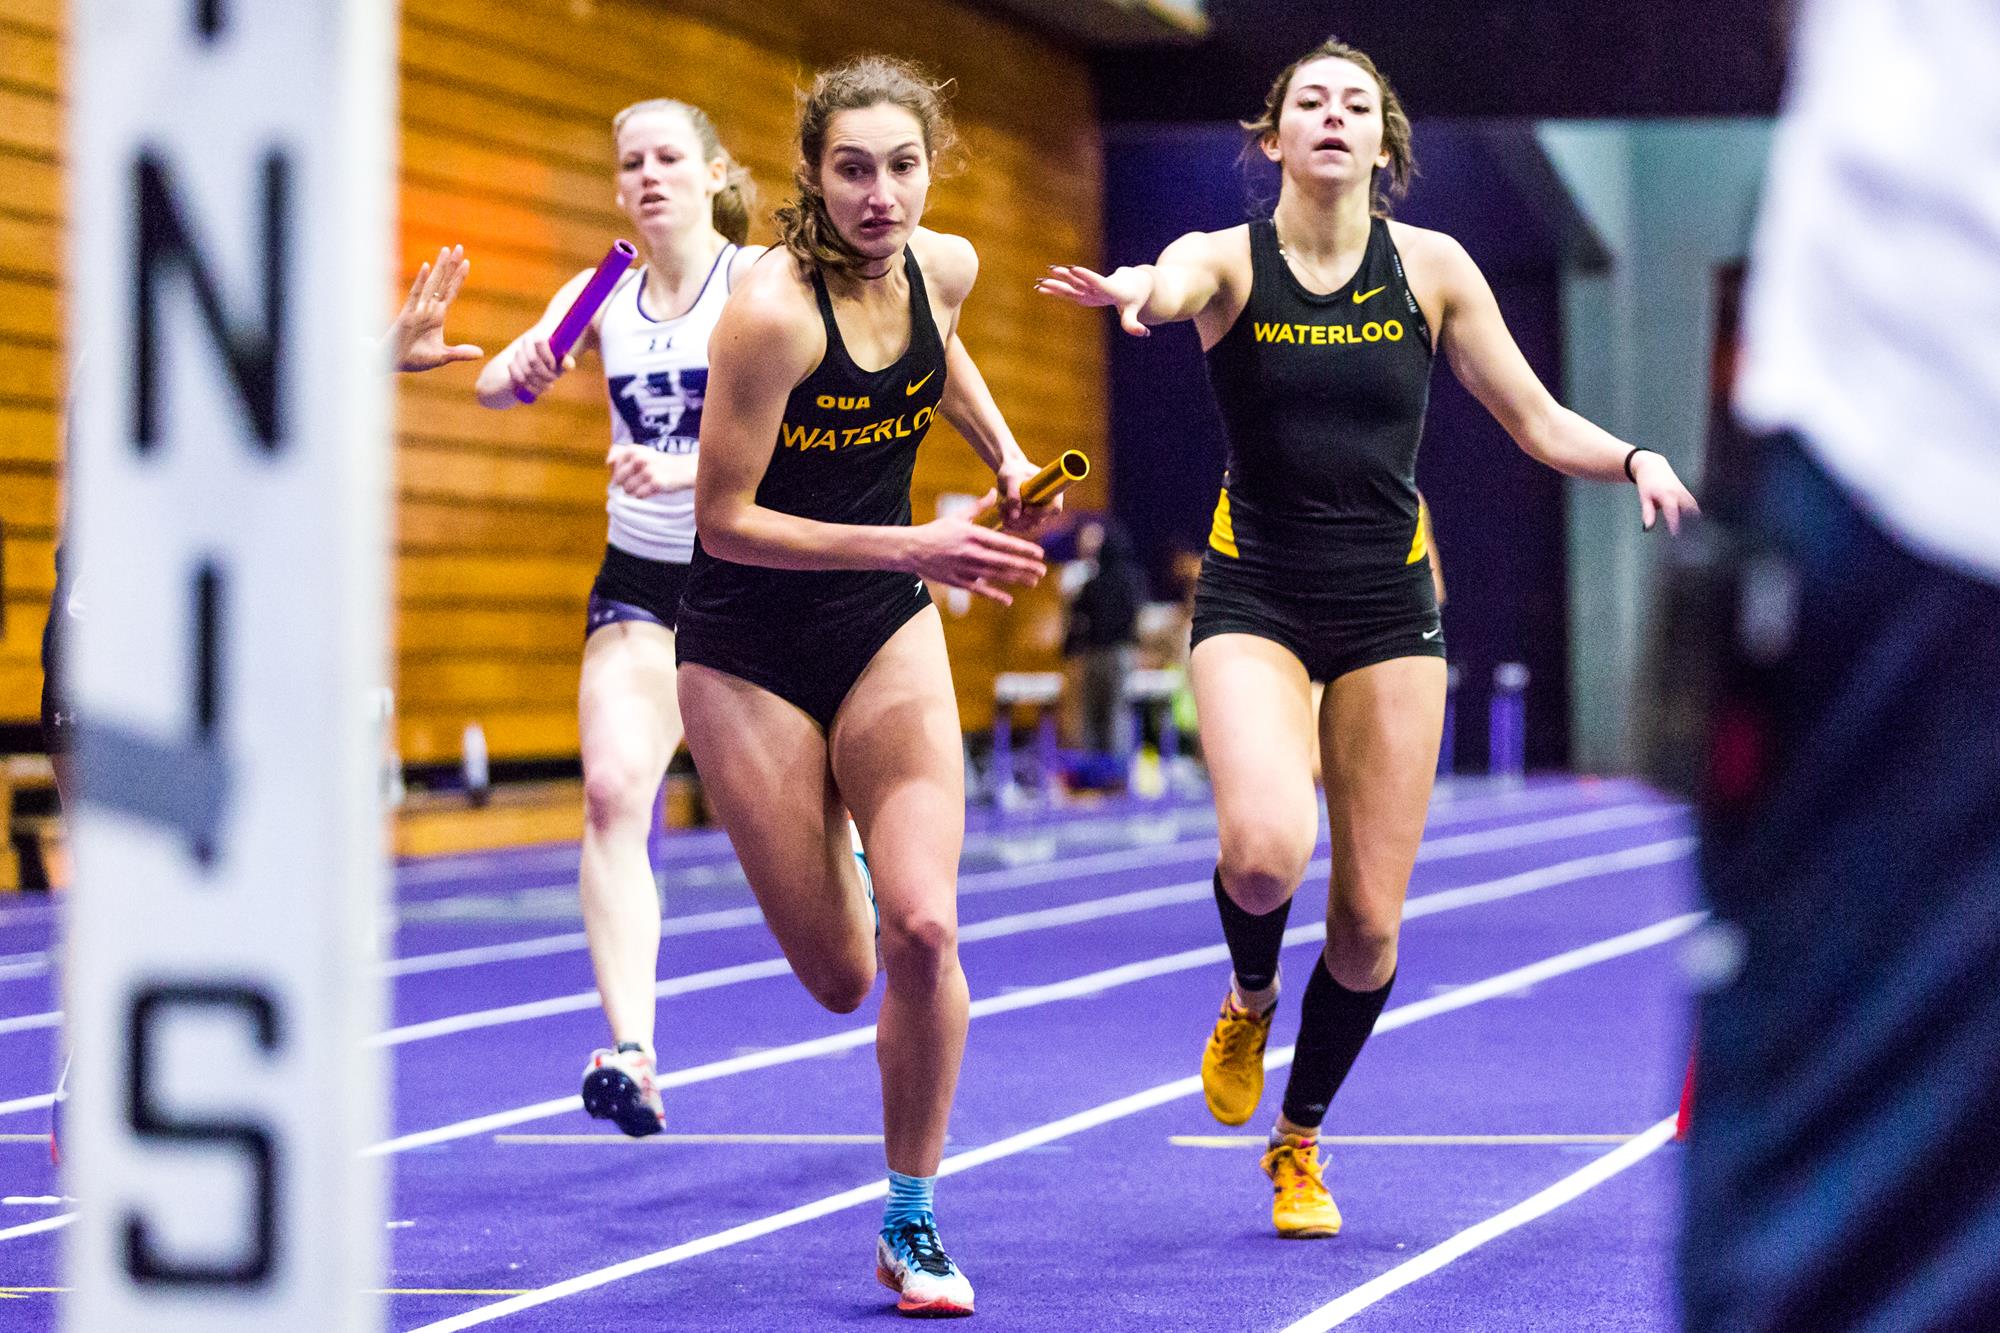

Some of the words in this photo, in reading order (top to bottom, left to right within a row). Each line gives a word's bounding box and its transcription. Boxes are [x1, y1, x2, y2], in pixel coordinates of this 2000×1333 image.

[1253, 319, 1404, 345] WATERLOO
[816, 395, 871, 410] OUA
[119, 0, 297, 1292] NIS
